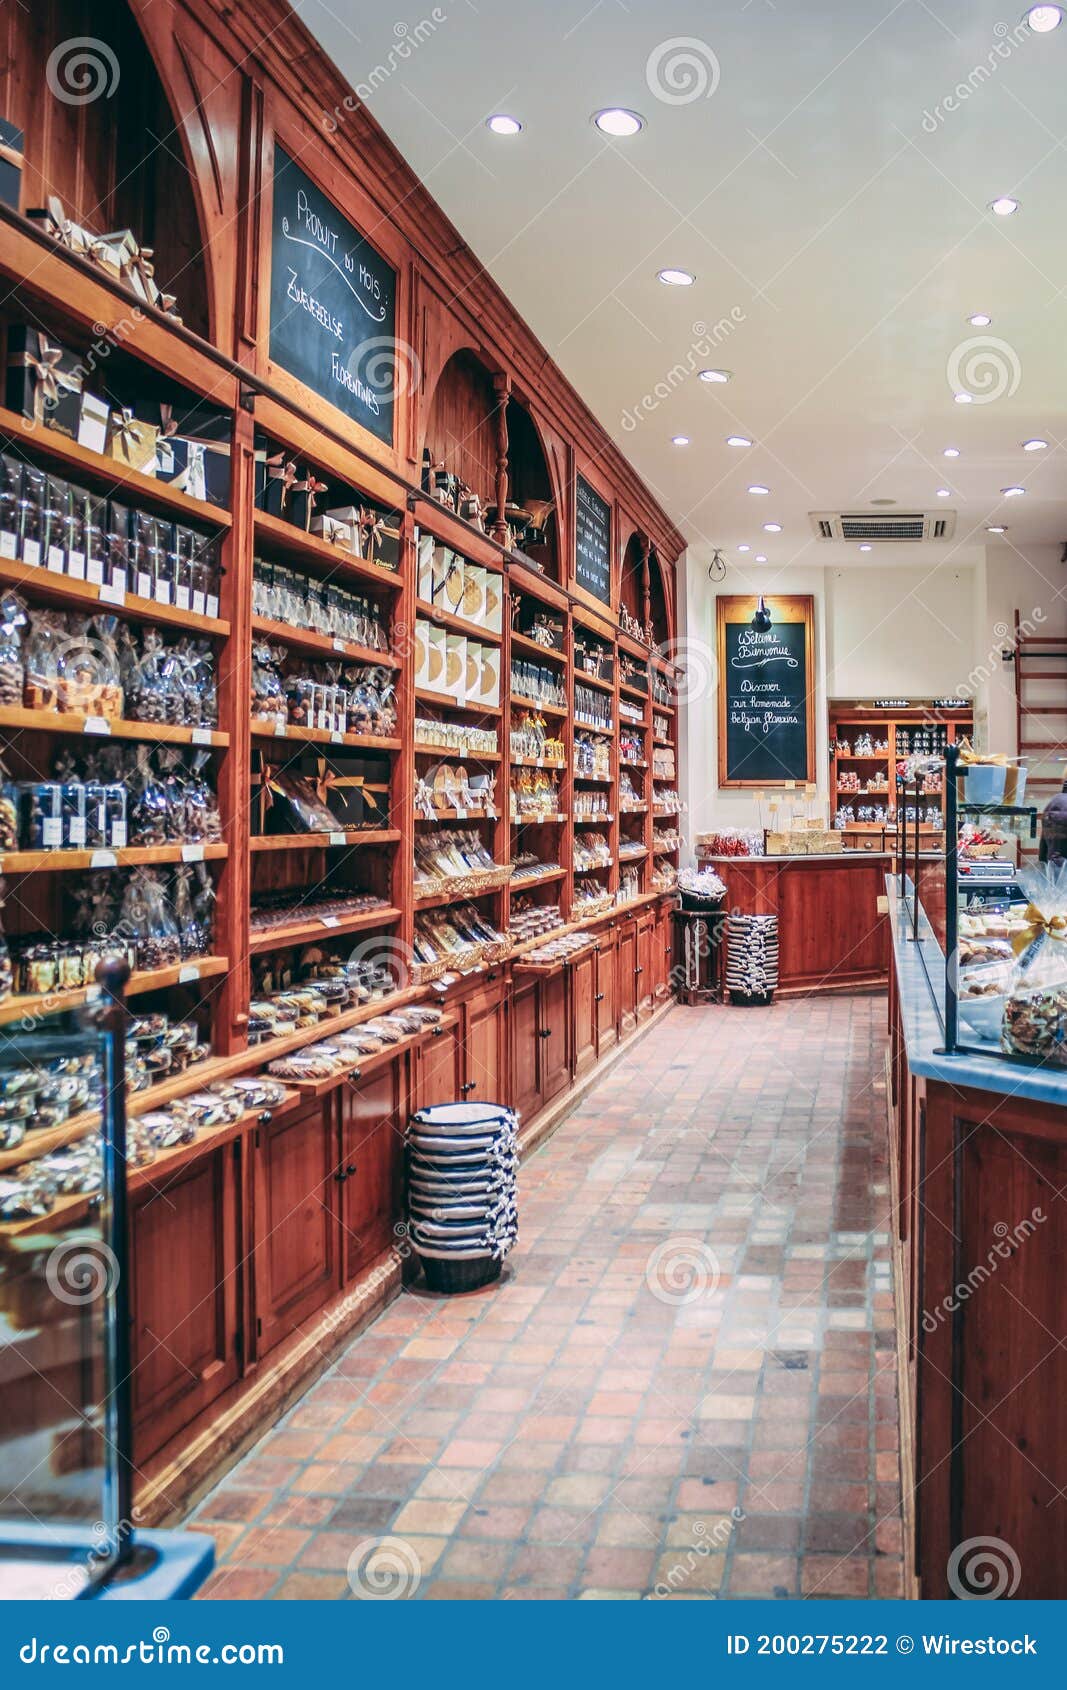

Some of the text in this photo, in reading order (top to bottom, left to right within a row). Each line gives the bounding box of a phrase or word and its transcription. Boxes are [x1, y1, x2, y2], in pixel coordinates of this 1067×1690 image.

[297, 189, 339, 254] PRODUIT
[331, 352, 379, 416] FLORENTINES
[738, 645, 791, 658] Bienvenue
[740, 679, 780, 692] Discover
[733, 695, 791, 708] our homemade
